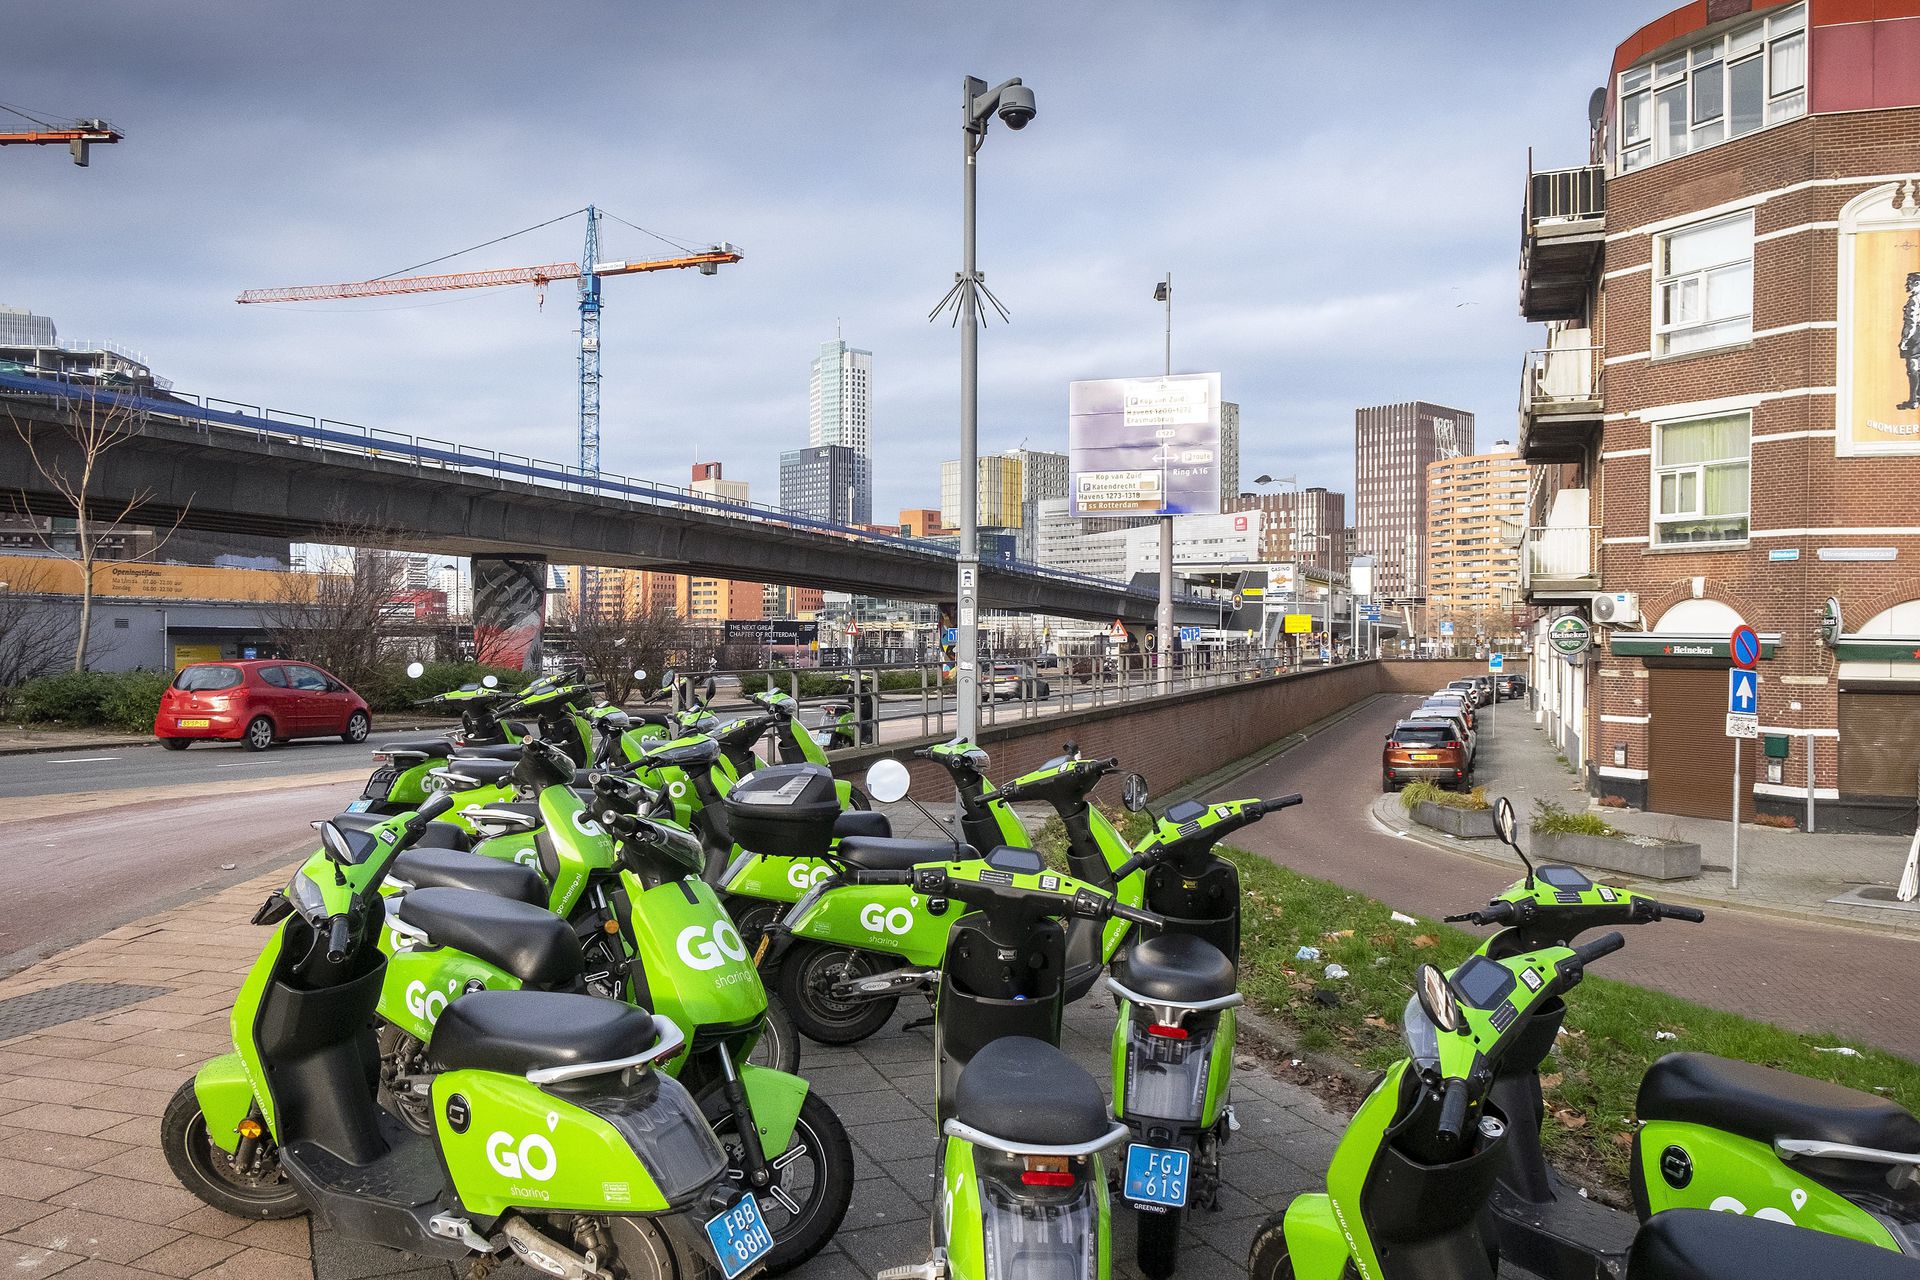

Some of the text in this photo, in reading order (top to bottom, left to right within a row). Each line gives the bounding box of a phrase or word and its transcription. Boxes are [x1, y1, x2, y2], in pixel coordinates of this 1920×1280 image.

[1172, 468, 1190, 476] Ring
[1673, 645, 1714, 655] Heineken
[556, 872, 582, 915] go-sharing.nl
[859, 902, 914, 935] GO
[675, 919, 747, 971] GO
[868, 935, 899, 948] sharing
[714, 969, 753, 989] sharing
[405, 979, 449, 1026] GO
[485, 1130, 557, 1182] GO
[1149, 1152, 1183, 1176] FGJ
[510, 1183, 550, 1201] sharing
[1146, 1176, 1181, 1200] 61S
[724, 1203, 755, 1237] FBB
[735, 1225, 768, 1260] 88H
